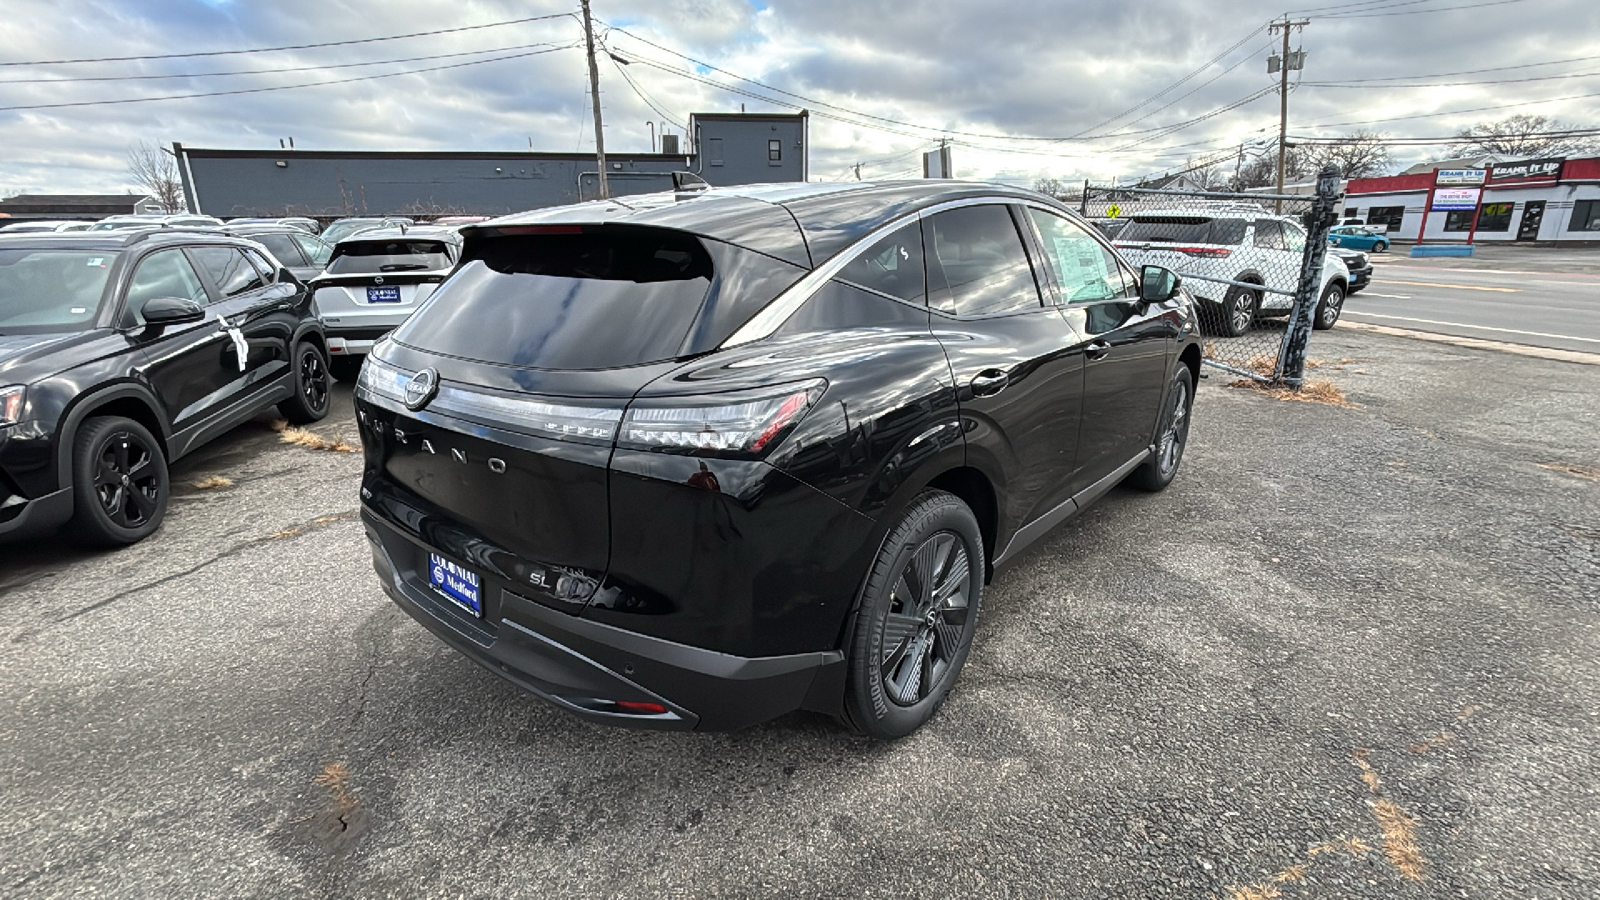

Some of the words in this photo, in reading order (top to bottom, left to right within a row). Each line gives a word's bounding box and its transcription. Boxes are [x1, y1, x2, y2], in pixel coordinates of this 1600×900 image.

[430, 552, 479, 588] COLONIAL
[529, 572, 553, 589] SL
[446, 574, 478, 603] Medford
